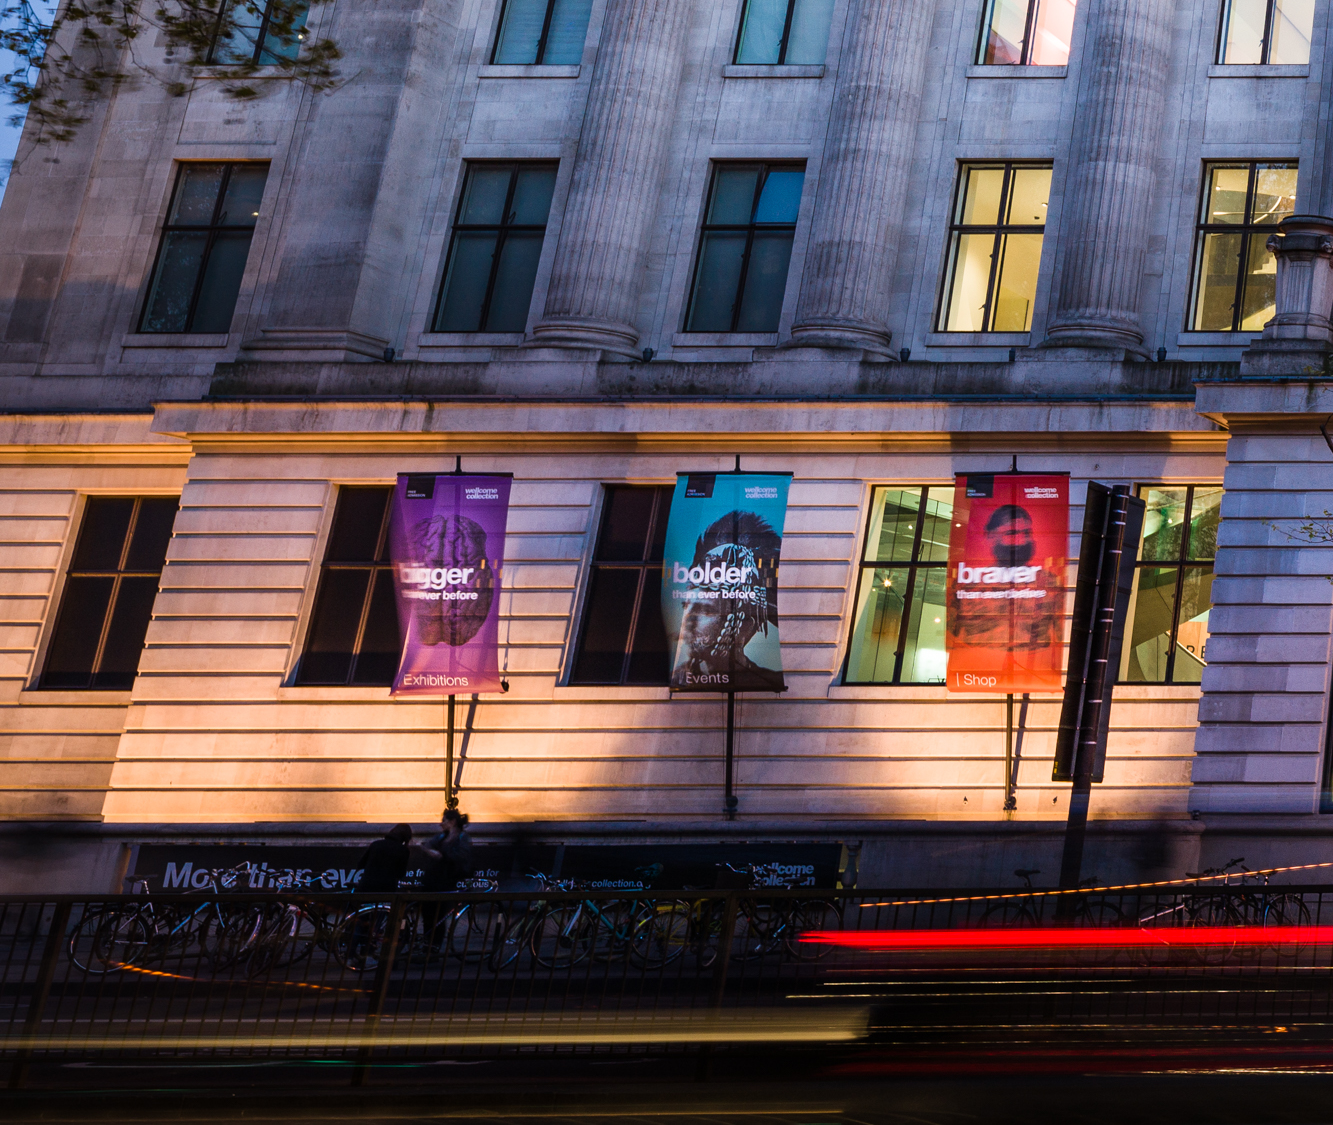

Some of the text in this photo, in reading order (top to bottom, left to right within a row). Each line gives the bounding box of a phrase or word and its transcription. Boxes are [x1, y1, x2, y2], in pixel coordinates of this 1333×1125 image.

[672, 561, 751, 584] bolder
[956, 562, 1043, 584] braver
[442, 590, 479, 600] before
[671, 590, 696, 599] than
[722, 590, 756, 599] before
[403, 673, 469, 687] Exhibitions
[685, 672, 730, 684] Events
[963, 673, 997, 687] Shop
[456, 880, 490, 888] cuous
[757, 875, 816, 886] ollen
